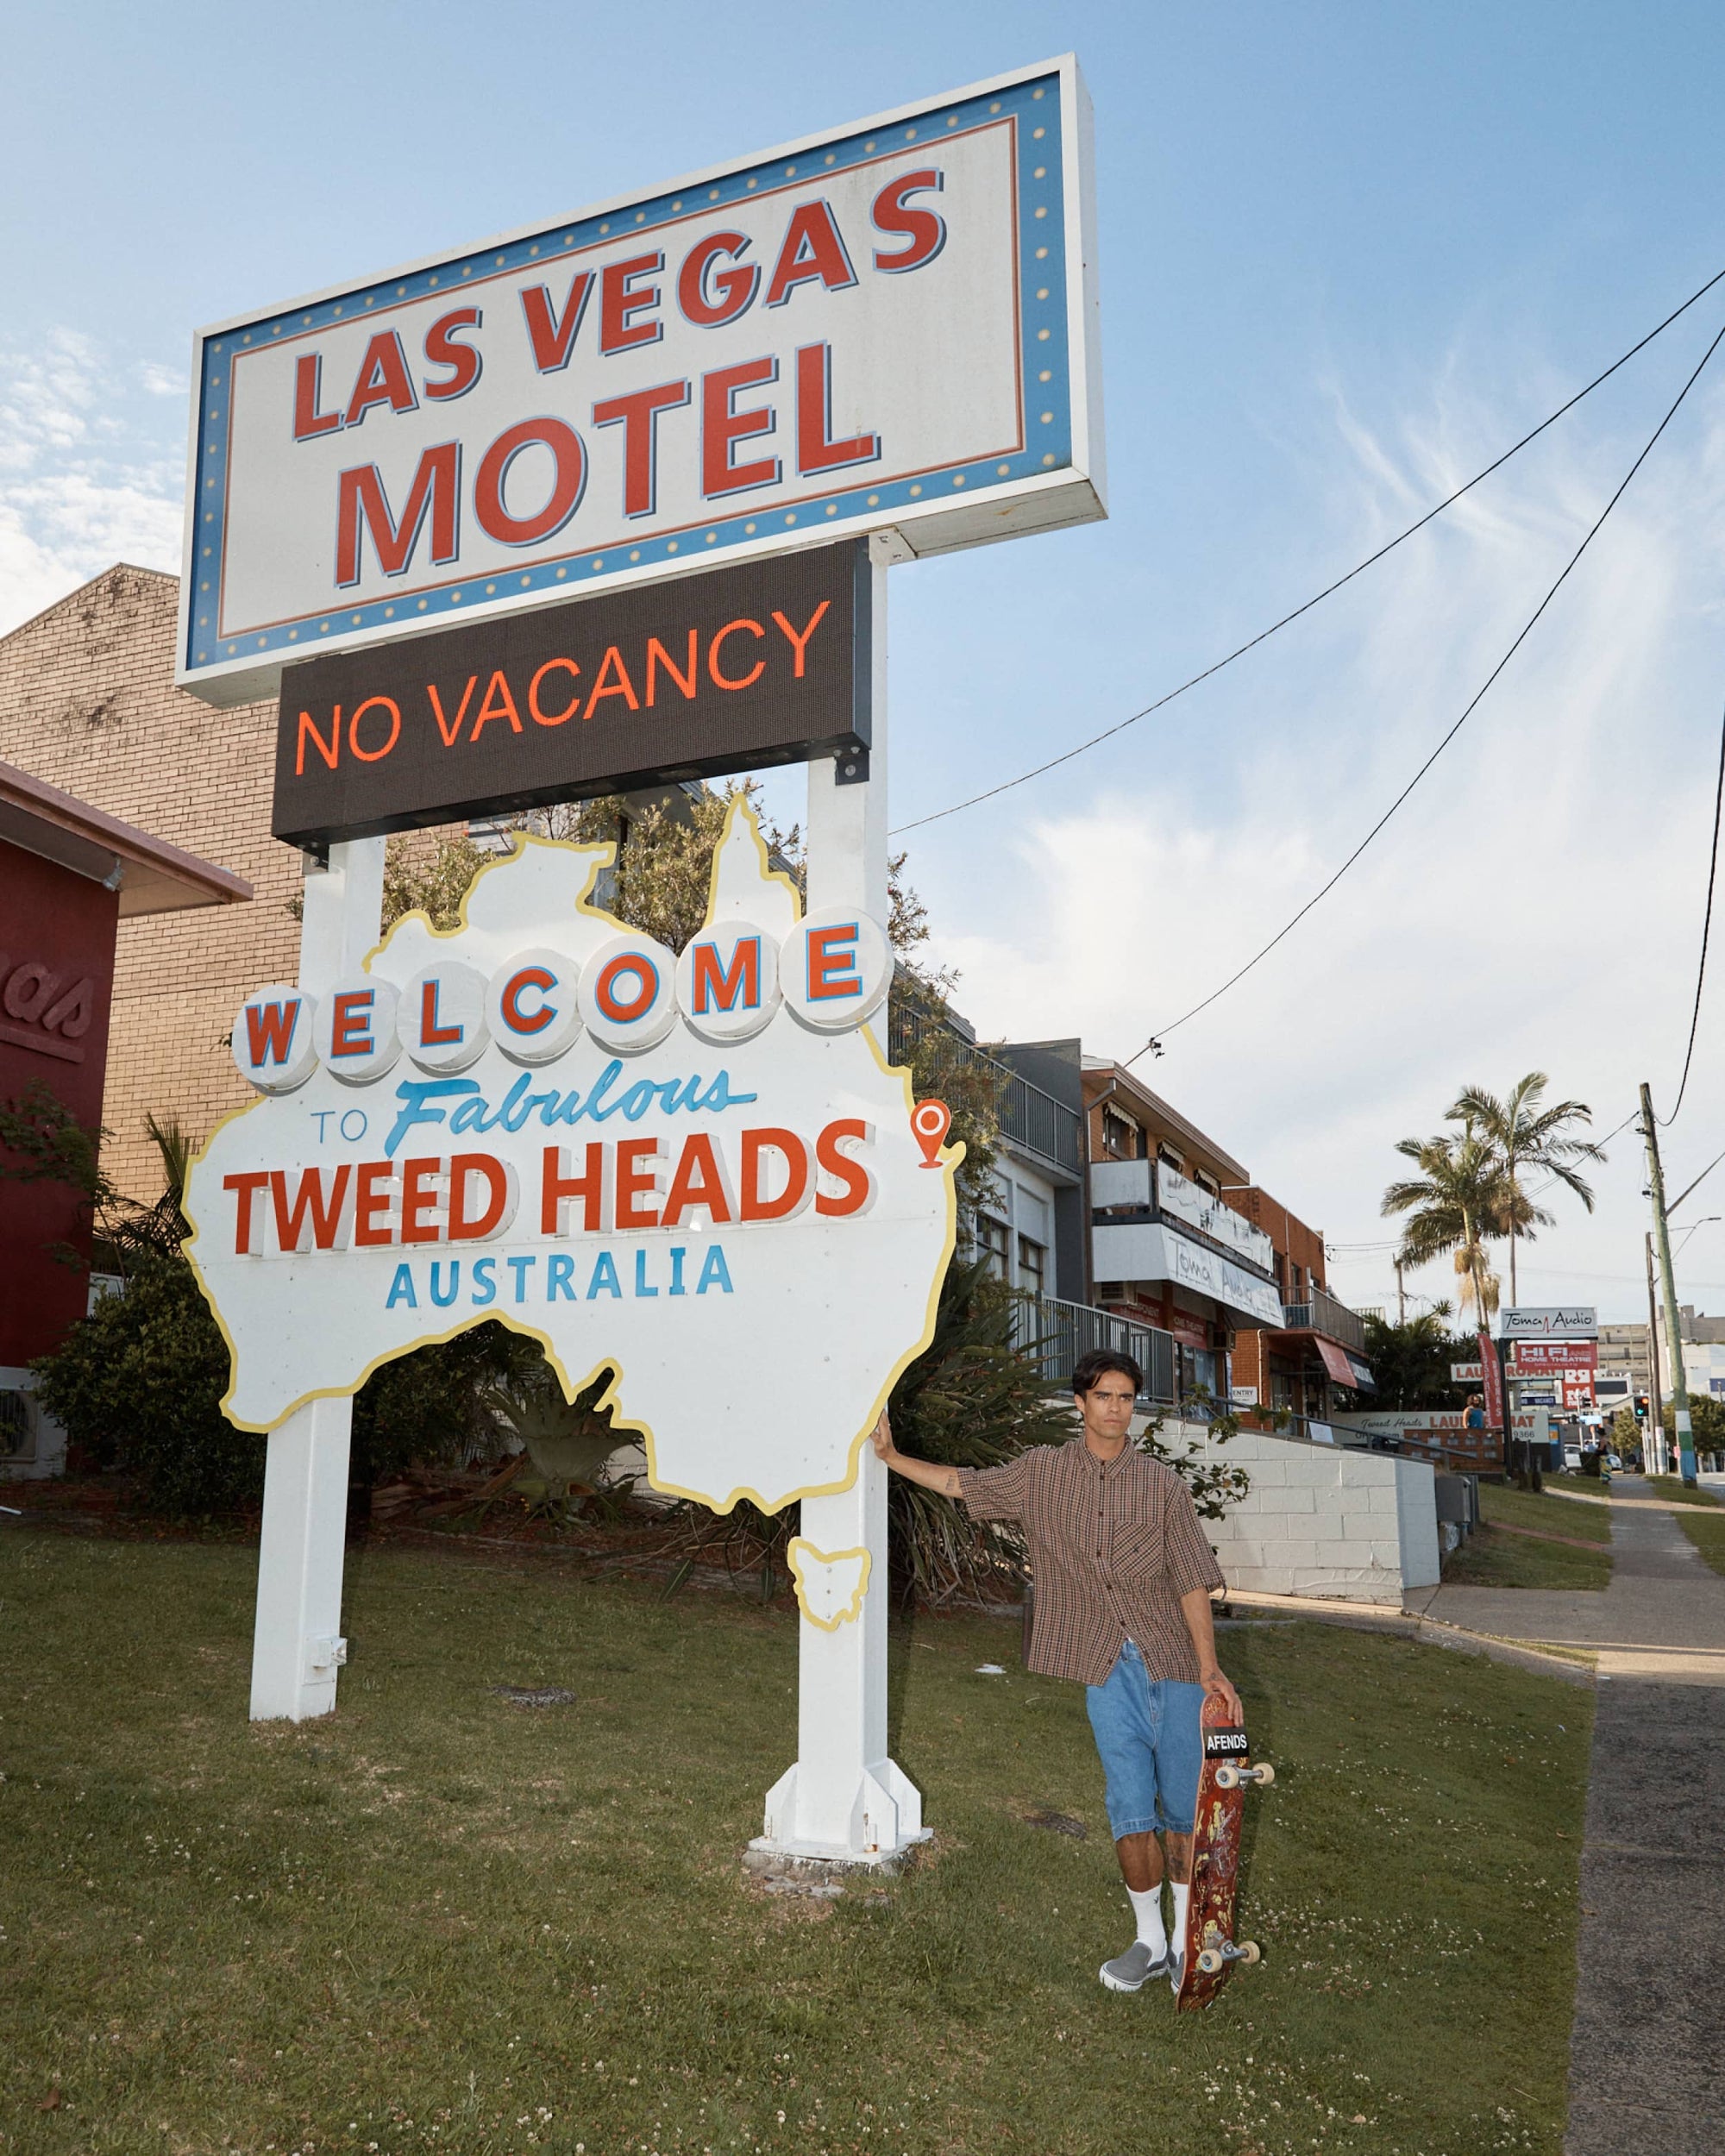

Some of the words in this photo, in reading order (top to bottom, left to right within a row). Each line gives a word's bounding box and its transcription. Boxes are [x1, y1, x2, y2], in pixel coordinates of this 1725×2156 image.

[292, 305, 483, 443] LAS
[518, 166, 948, 375] VEGAS
[335, 340, 881, 589] MOTEL
[296, 695, 401, 775] NO
[428, 601, 831, 748] VACANCY
[245, 921, 862, 1069] WELCOME
[310, 1109, 367, 1144] TO
[385, 1059, 757, 1158] Fabulous
[223, 1152, 511, 1255] TWEED
[541, 1118, 873, 1235] HEADS
[386, 1244, 734, 1309] AUSTRALIA
[1504, 1313, 1542, 1329] Toma
[1552, 1312, 1592, 1328] Audio
[1521, 1347, 1544, 1357] HI
[1548, 1347, 1568, 1357] FI
[1456, 1365, 1557, 1377] LAUROMAT
[1361, 1419, 1390, 1430] Tweed
[1393, 1417, 1423, 1427] Heads
[1207, 1733, 1247, 1751] AFENDS
